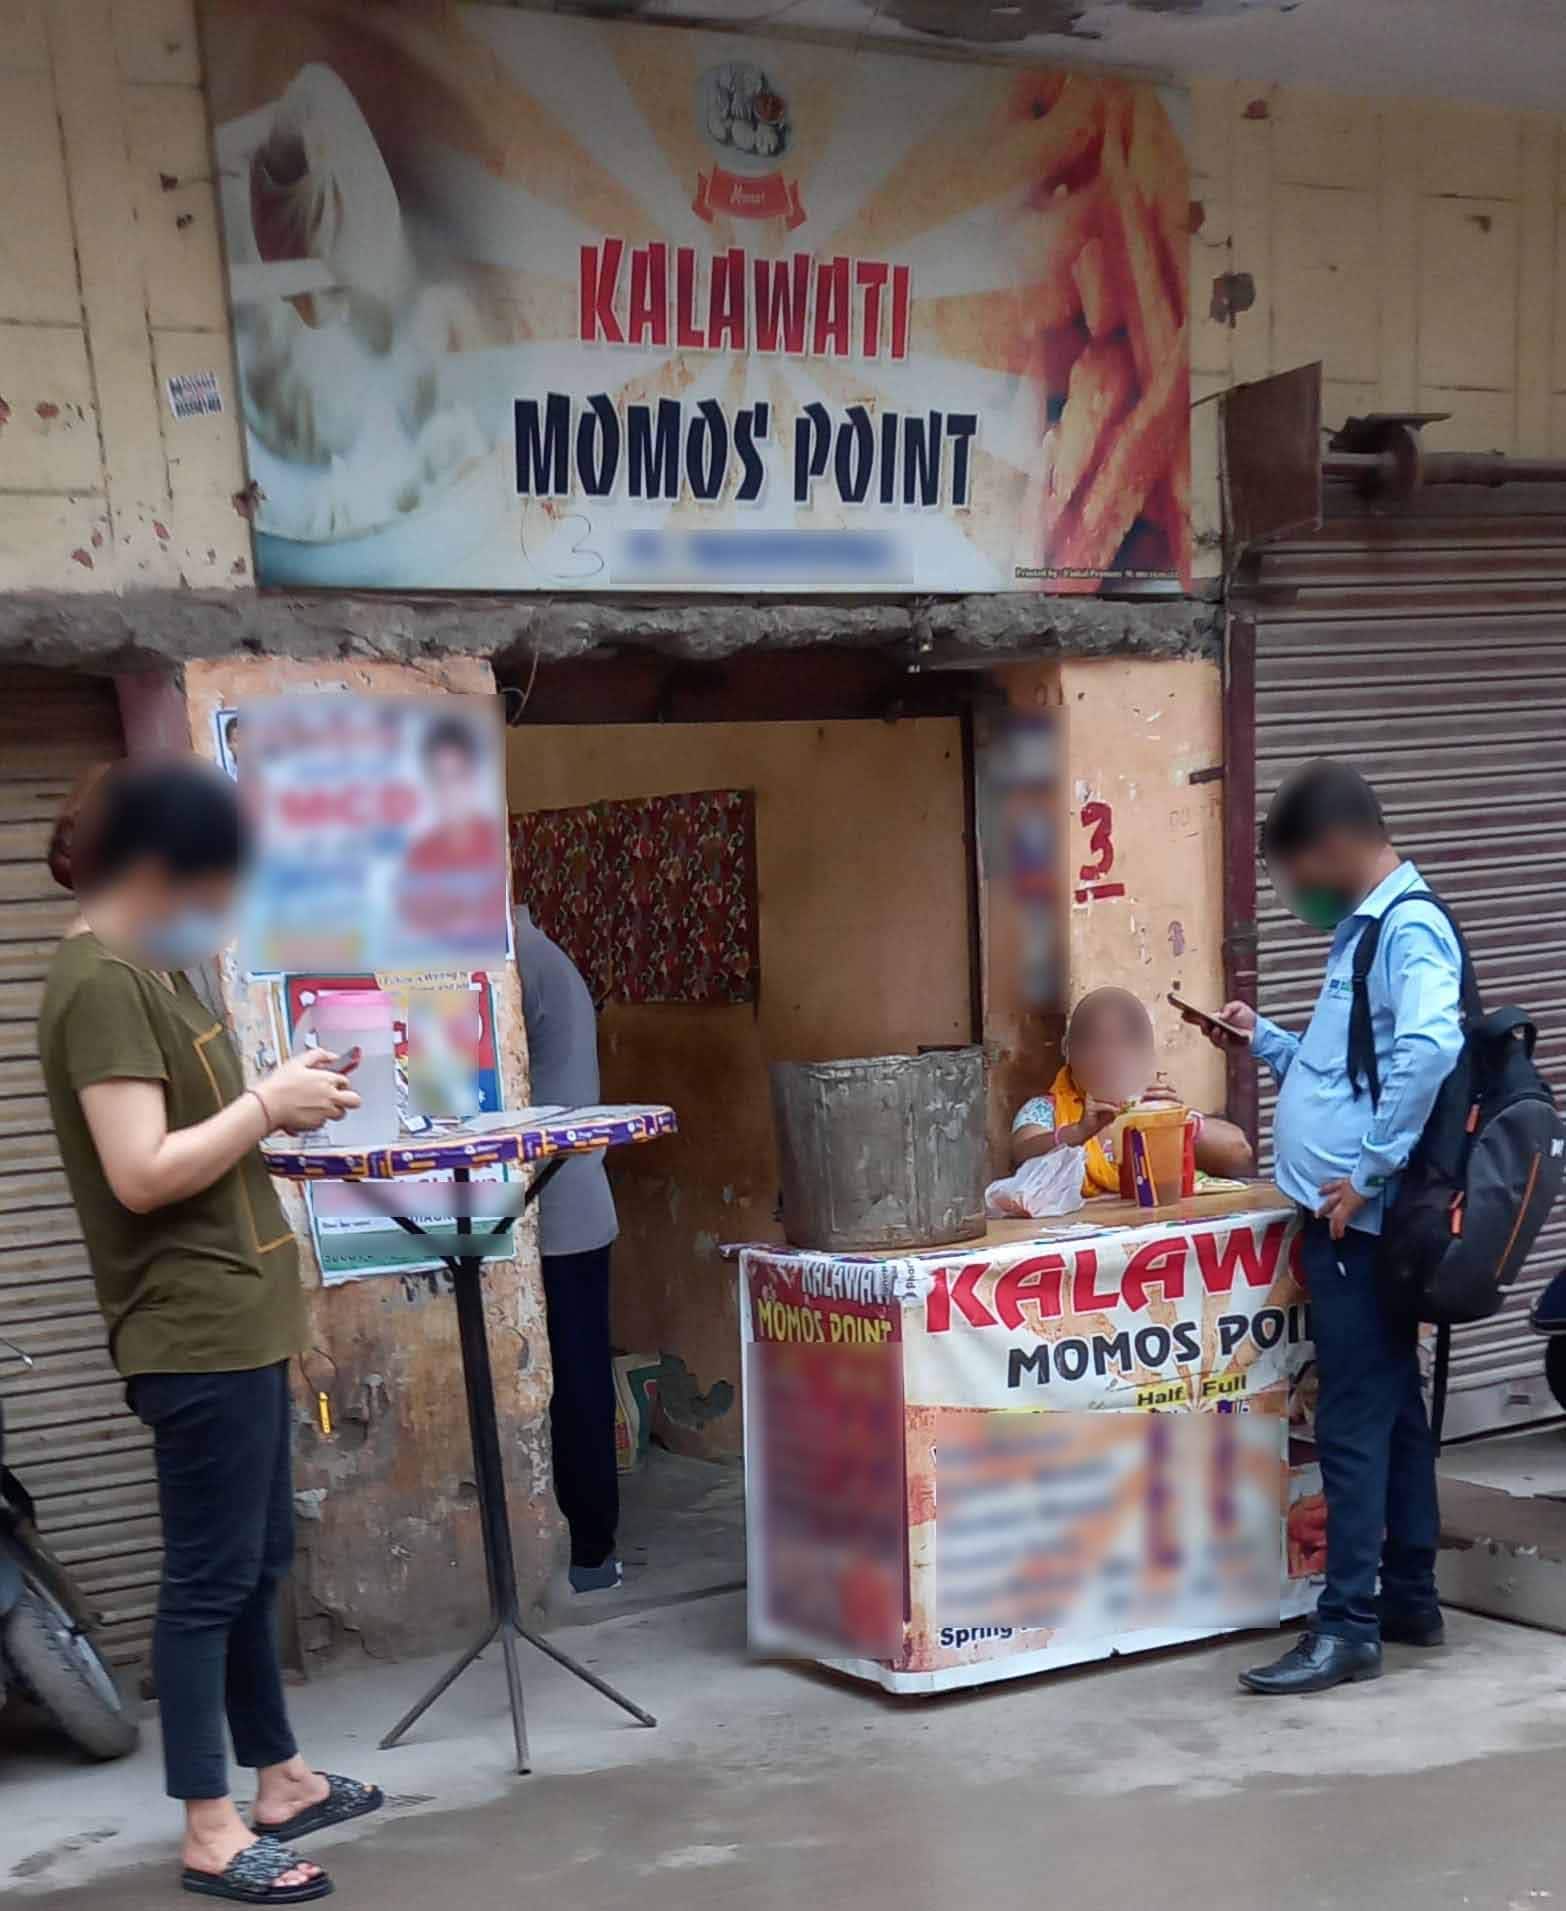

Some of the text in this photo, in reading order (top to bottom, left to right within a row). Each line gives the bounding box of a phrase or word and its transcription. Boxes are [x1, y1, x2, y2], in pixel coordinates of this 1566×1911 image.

[579, 238, 910, 360] KALAWATI
[513, 392, 978, 507] MOMOS POINT
[757, 1298, 826, 1343] MOMOS
[925, 1222, 1311, 1333] KALAW
[1008, 1320, 1201, 1388] MOMOS
[1137, 1374, 1247, 1407] Half Full
